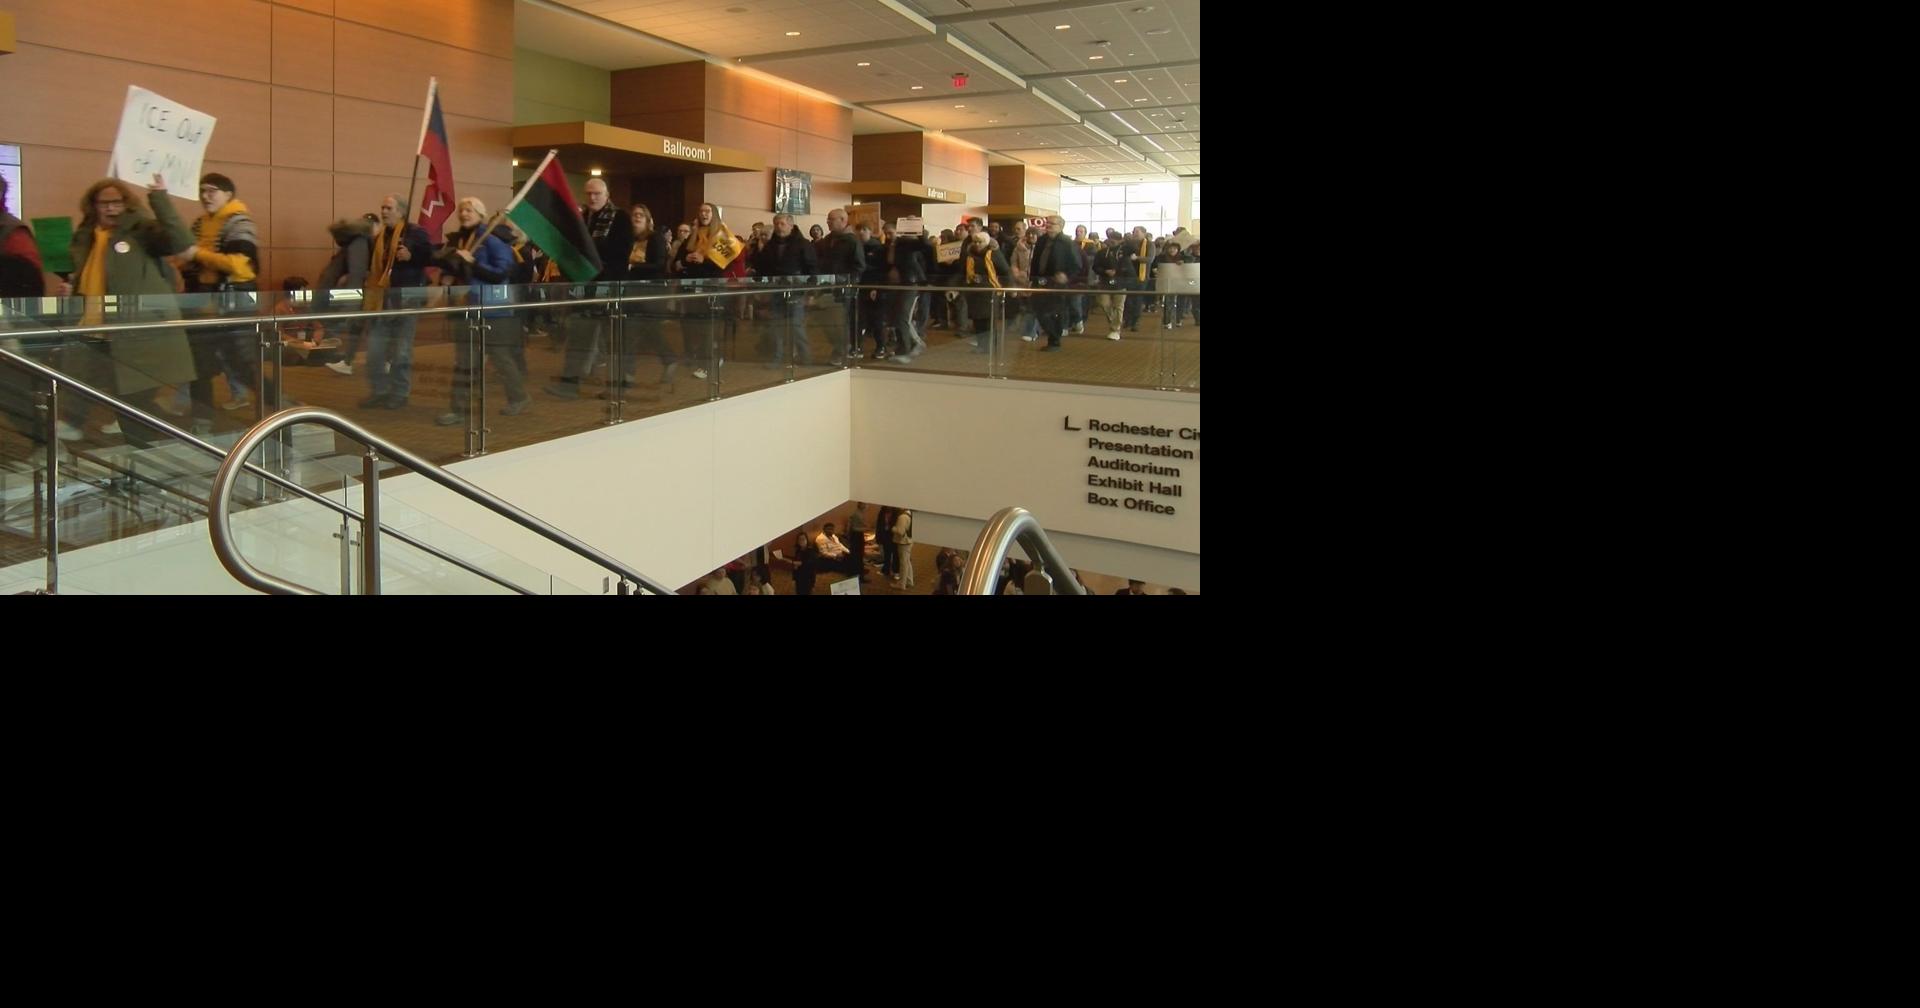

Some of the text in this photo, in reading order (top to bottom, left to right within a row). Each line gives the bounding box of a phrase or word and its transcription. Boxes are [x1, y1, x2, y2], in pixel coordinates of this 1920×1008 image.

[140, 102, 204, 144] ICE Out
[663, 138, 712, 161] Ballroom 1
[1089, 419, 1173, 437] Rochester
[1088, 438, 1193, 459] Presentation
[1087, 455, 1180, 477] Auditorium
[1087, 474, 1182, 497] Exhibit Hall
[1087, 492, 1176, 515] Box Office
